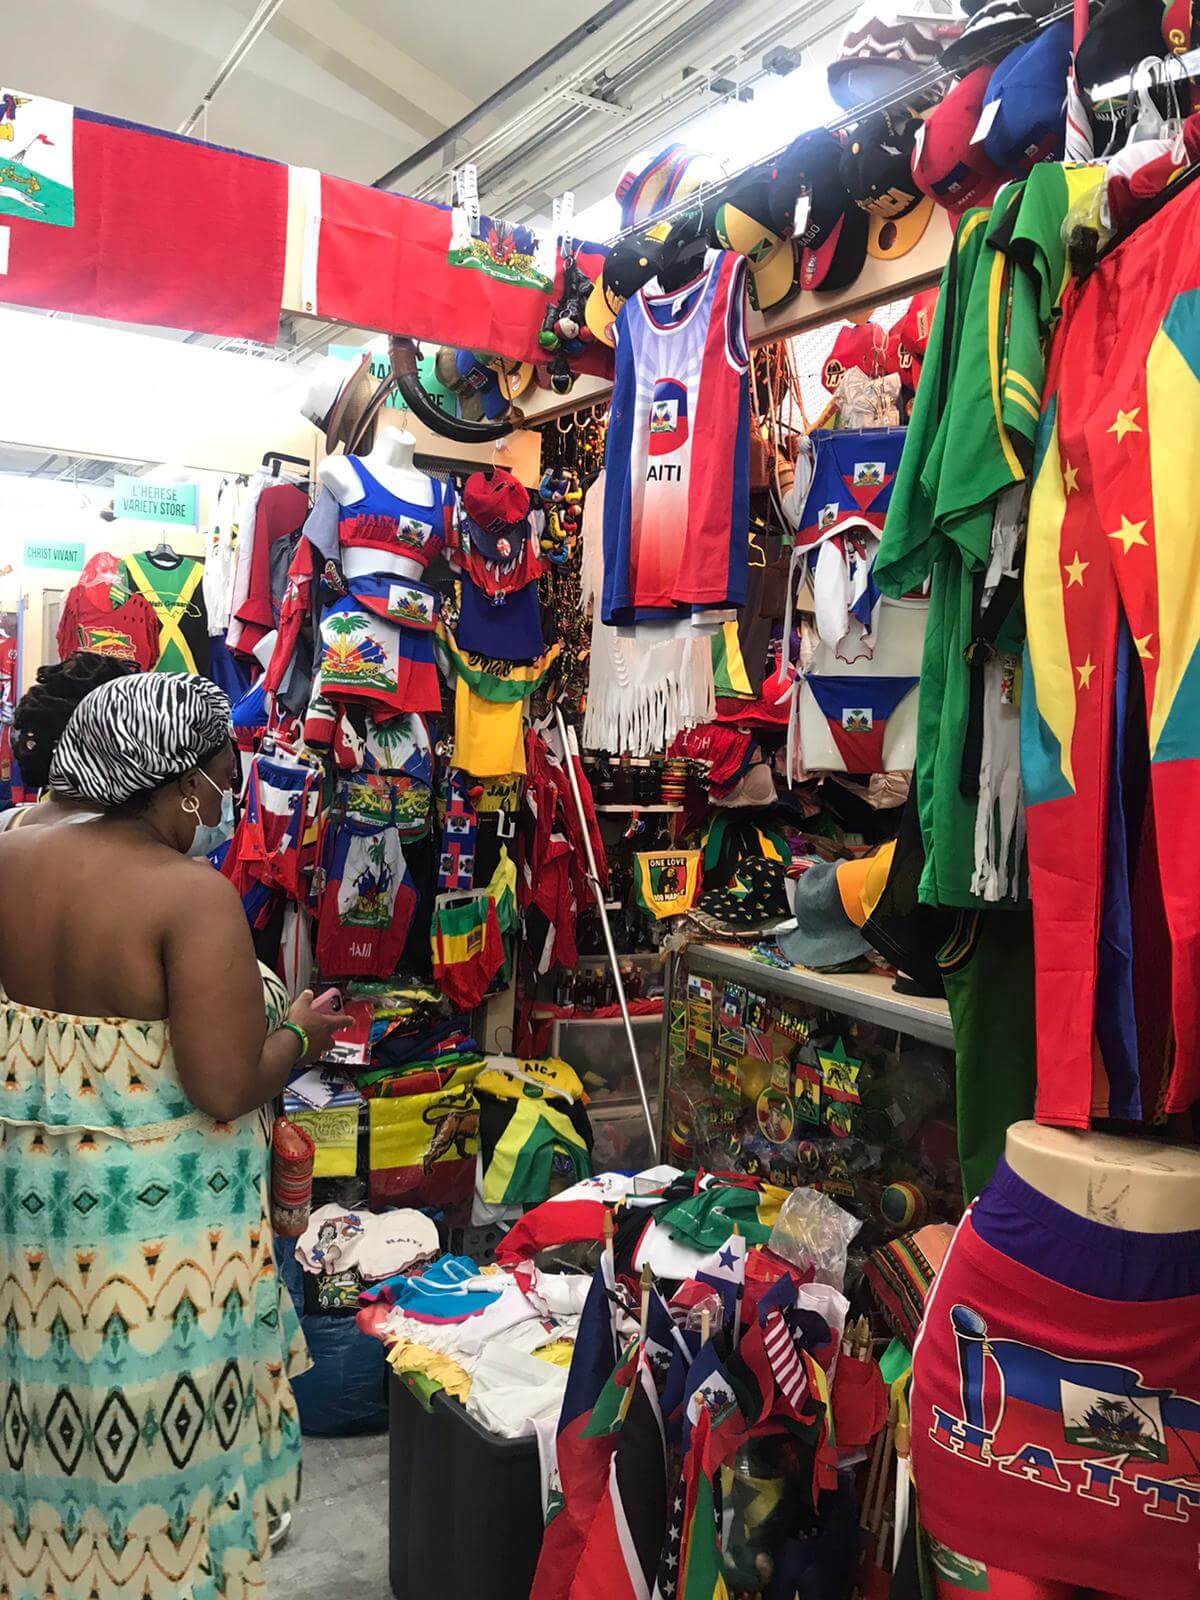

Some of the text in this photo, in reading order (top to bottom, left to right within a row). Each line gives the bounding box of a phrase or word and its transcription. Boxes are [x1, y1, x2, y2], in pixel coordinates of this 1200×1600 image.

[645, 464, 682, 482] AITI
[123, 496, 187, 518] VARIETY STORE
[27, 546, 78, 562] CHRIST VIVANT
[649, 858, 685, 868] ONE LOVE
[928, 1404, 1200, 1523] HAIT
